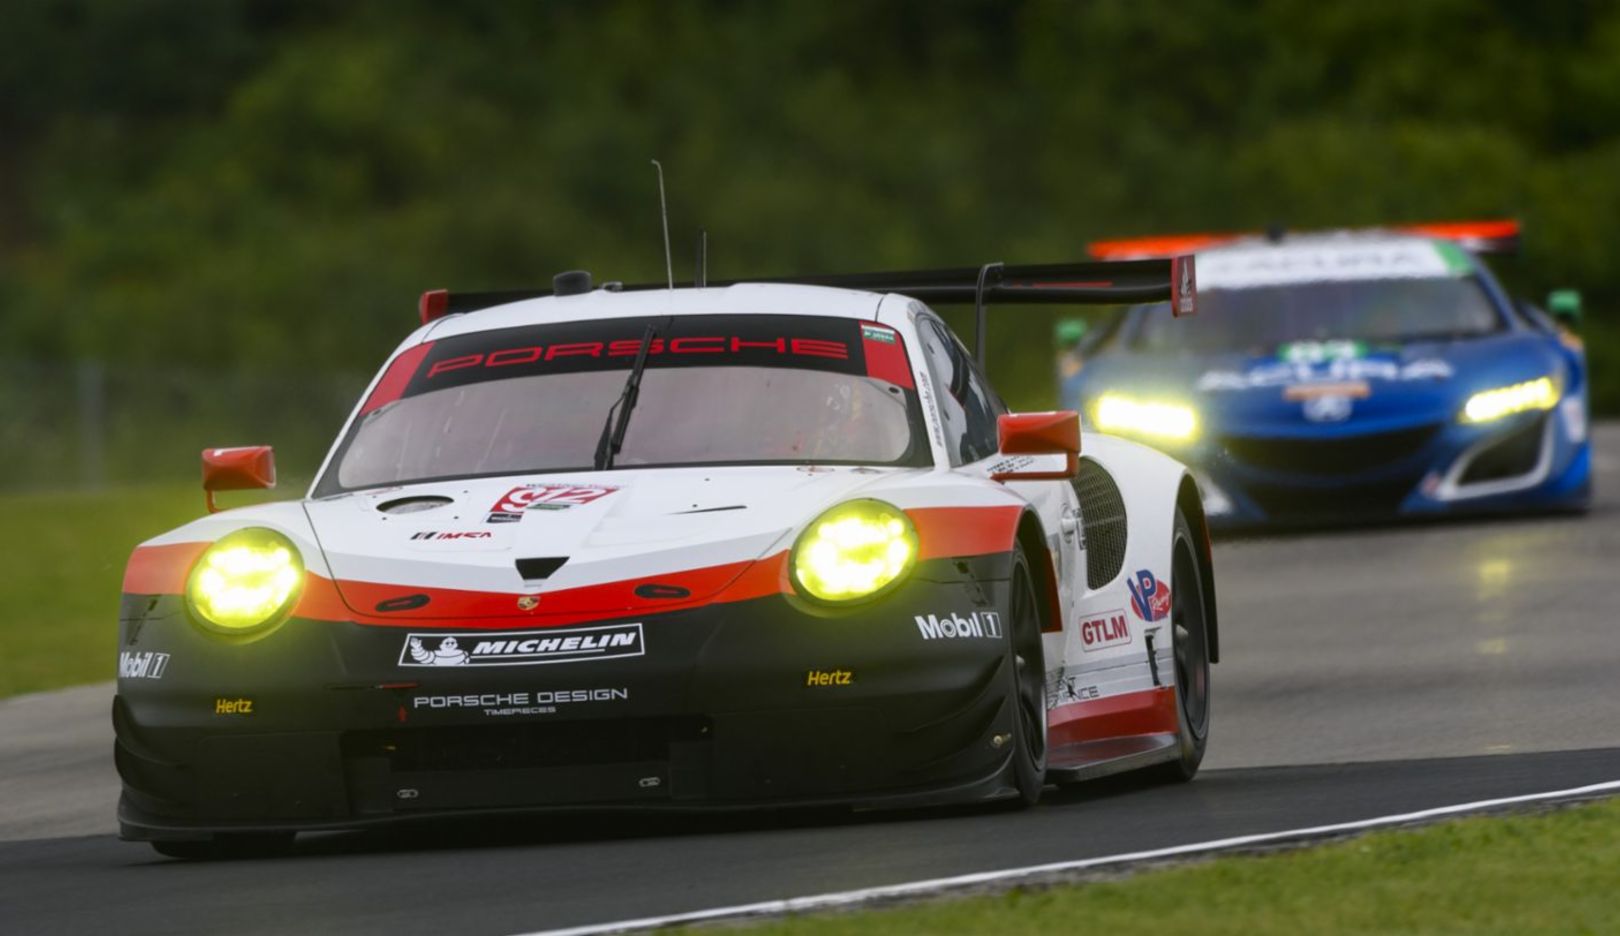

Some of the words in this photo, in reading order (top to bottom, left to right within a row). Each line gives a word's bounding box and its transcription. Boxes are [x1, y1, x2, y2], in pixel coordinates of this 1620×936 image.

[427, 335, 849, 378] PORSCHE
[914, 612, 983, 640] Mobil
[983, 612, 1000, 637] 1
[1082, 615, 1129, 646] GTLM
[472, 632, 637, 655] MICHELIN
[807, 670, 852, 686] Hertz
[215, 698, 252, 714] Hertz
[414, 692, 529, 708] PORSCHE
[537, 687, 629, 703] DESIGN
[483, 706, 557, 716] TIMEPIECES
